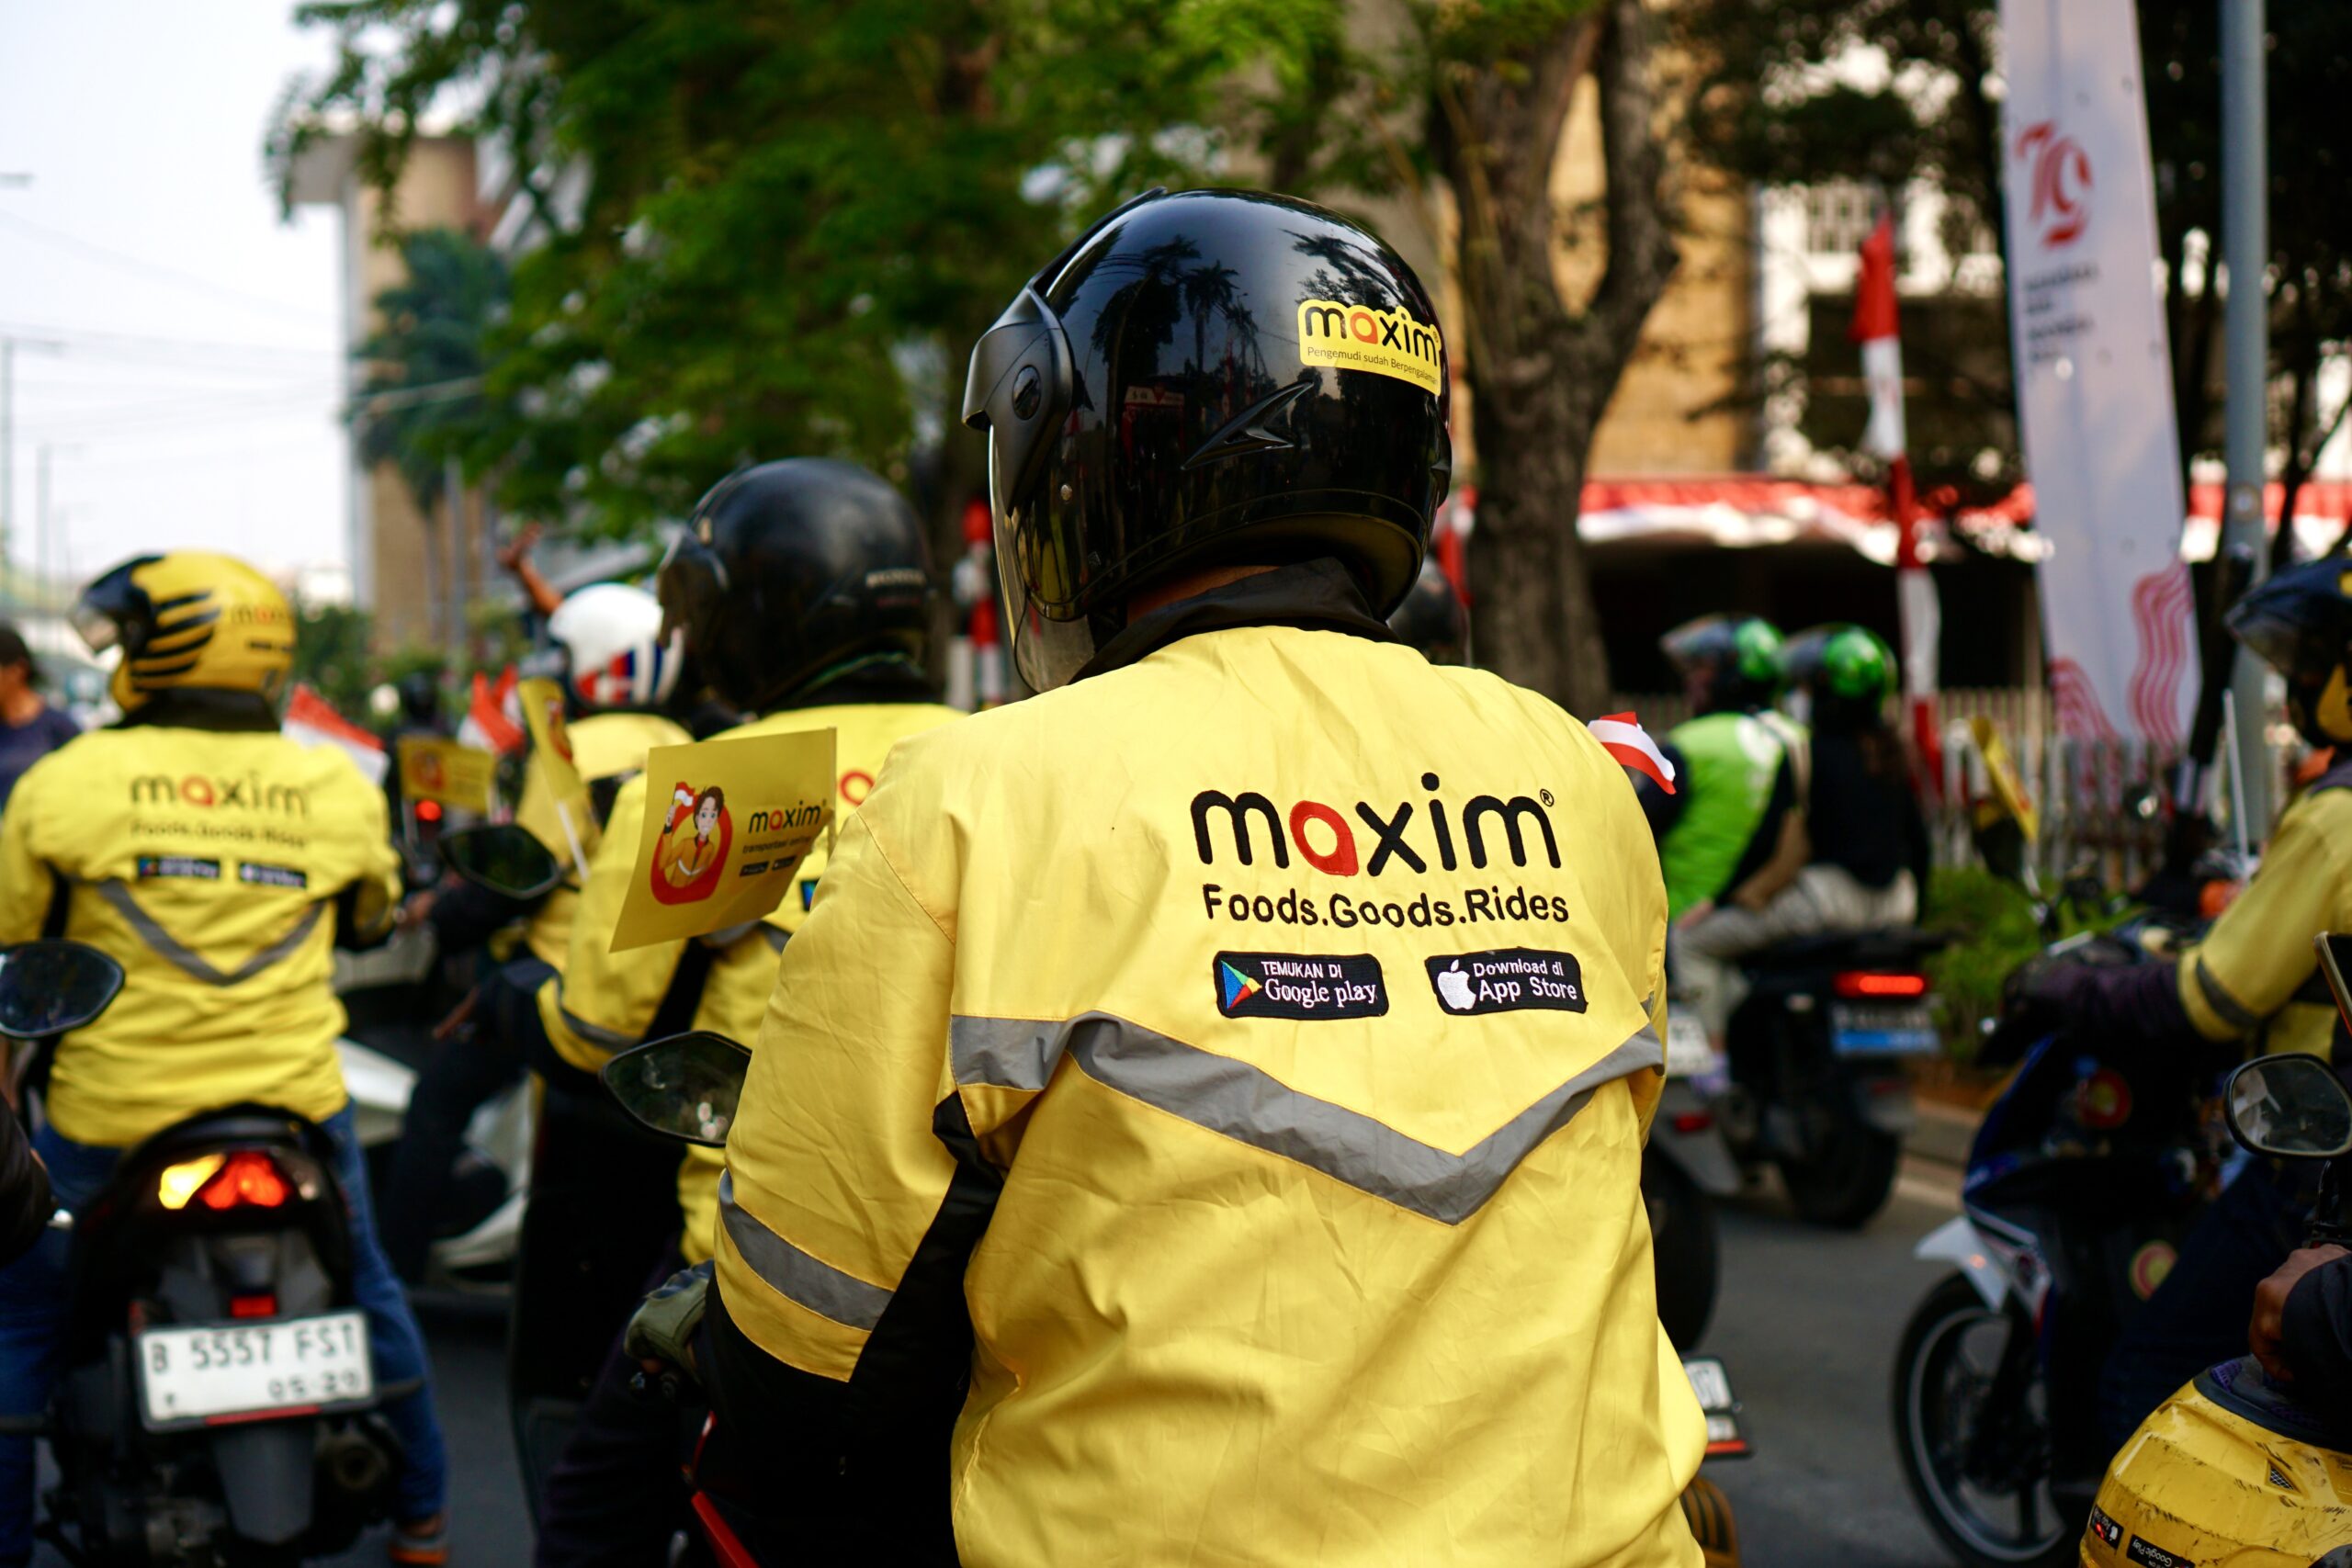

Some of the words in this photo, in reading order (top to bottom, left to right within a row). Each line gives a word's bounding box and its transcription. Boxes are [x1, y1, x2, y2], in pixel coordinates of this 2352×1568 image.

[1306, 306, 1438, 367] maxim
[1307, 346, 1362, 361] Pengemudi
[1363, 354, 1389, 367] sudah
[131, 772, 308, 817] maxim
[748, 800, 820, 834] maxim
[1191, 773, 1562, 876] maxim
[1261, 961, 1324, 979] TEMUKAN
[1329, 964, 1343, 979] DI
[1473, 958, 1548, 977] Download
[1264, 978, 1330, 1009] Google
[1334, 980, 1377, 1008] play
[1479, 979, 1521, 1004] App
[1529, 976, 1577, 1000] Store
[151, 1342, 168, 1373] B
[190, 1330, 272, 1370] 5557
[2132, 1539, 2146, 1555] Play
[2144, 1547, 2173, 1568] Google
